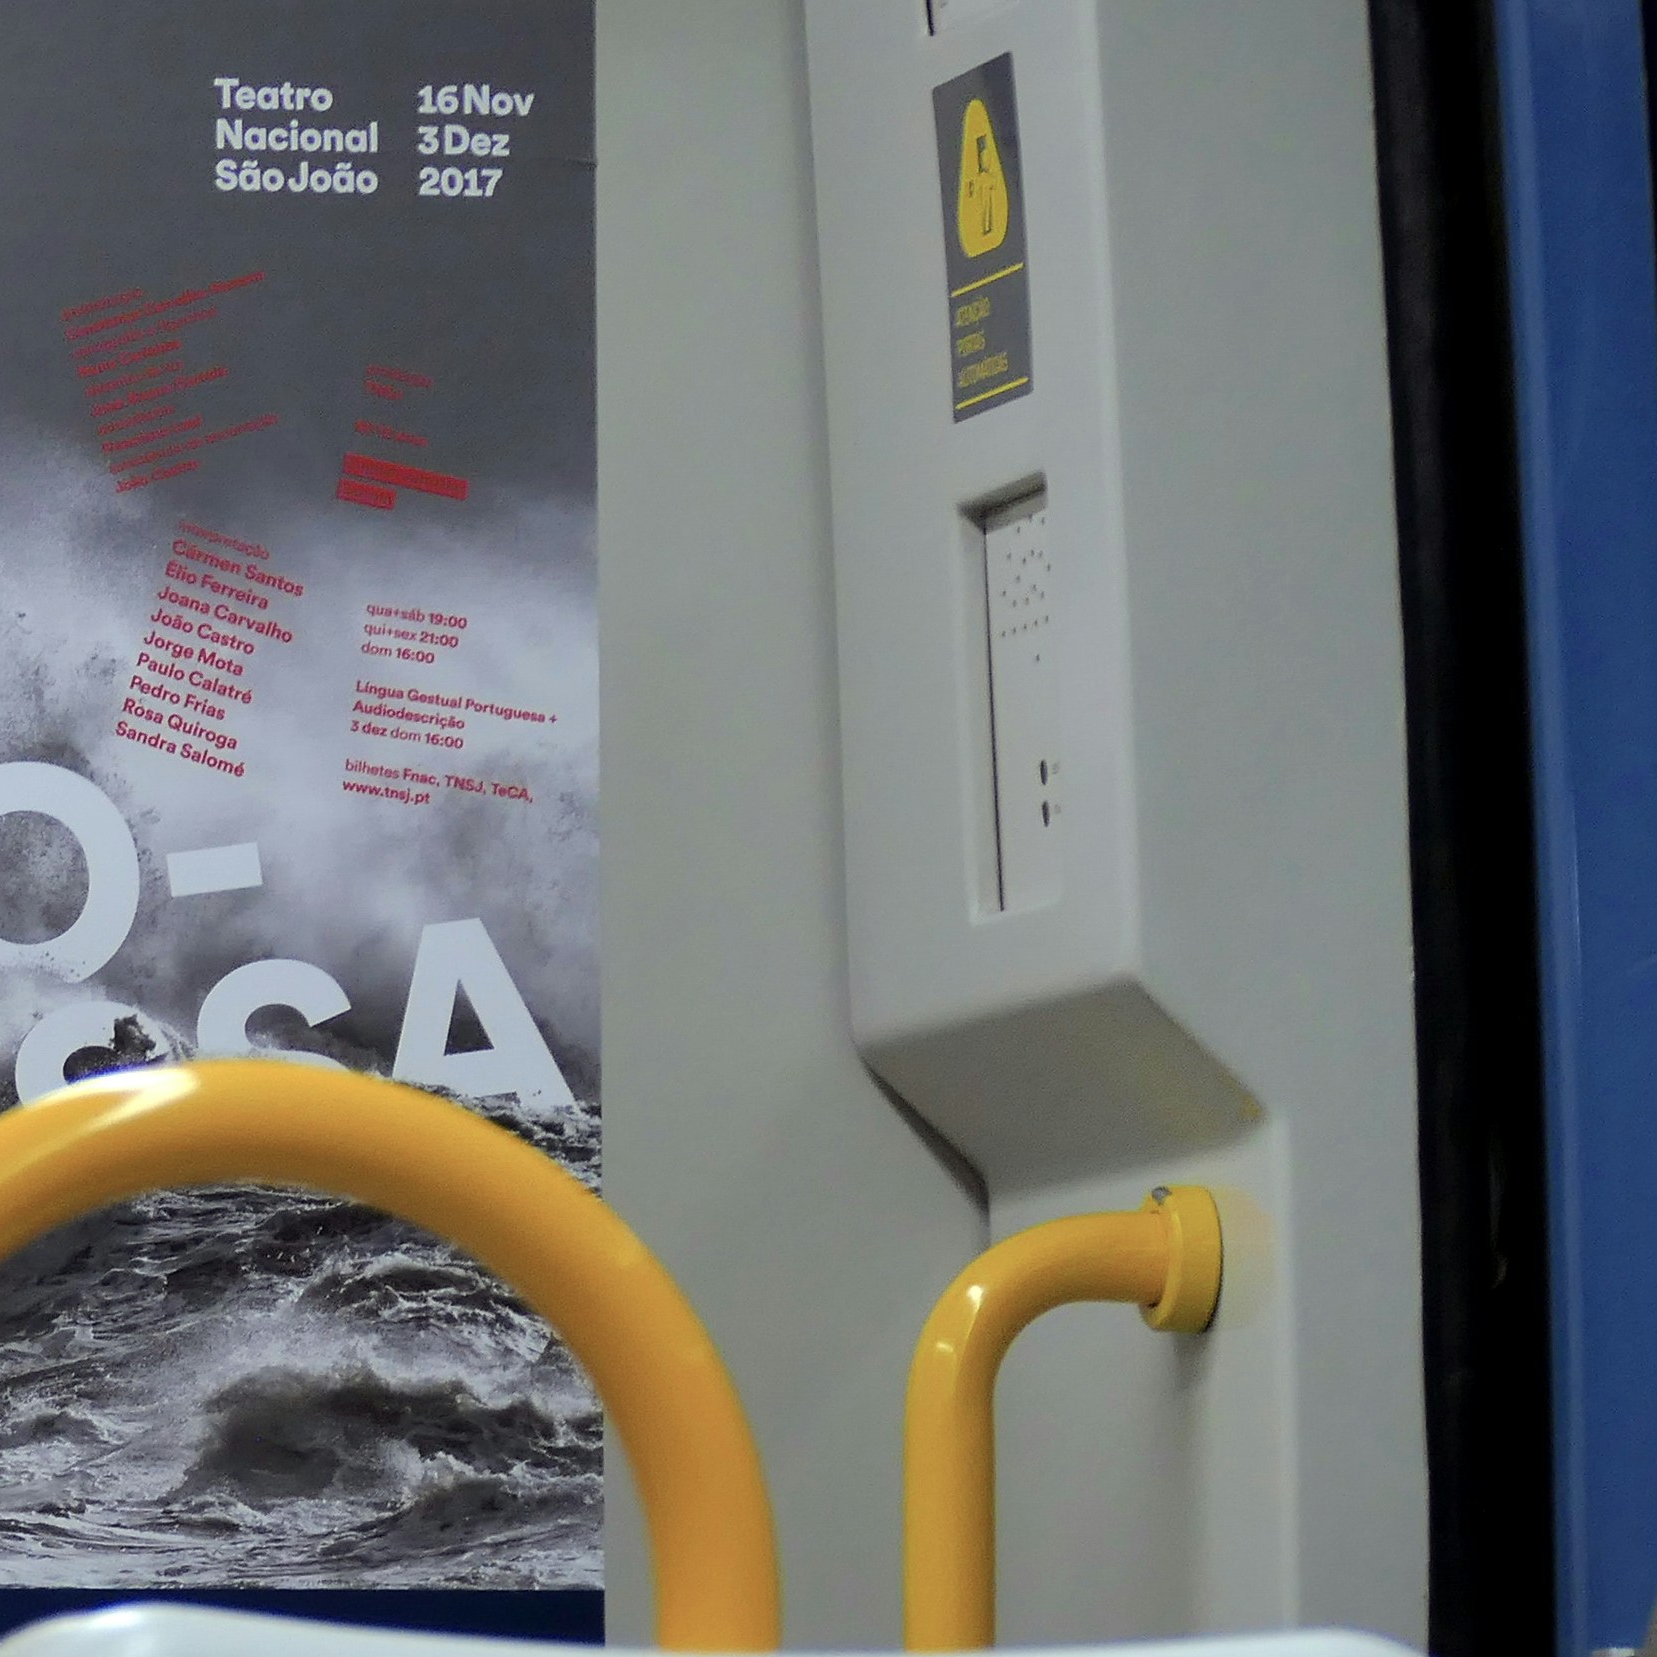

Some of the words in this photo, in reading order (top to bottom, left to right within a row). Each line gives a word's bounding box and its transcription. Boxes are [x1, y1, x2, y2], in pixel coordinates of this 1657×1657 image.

[214, 78, 333, 111] Teatro
[418, 85, 459, 114] 16
[463, 84, 535, 117] Nov
[216, 118, 378, 153] Nacional
[418, 126, 439, 155] 3
[443, 124, 510, 156] Dez
[215, 159, 284, 193] São
[288, 161, 378, 194] João
[418, 167, 503, 197] 2017
[201, 575, 269, 610] Ferreira
[244, 564, 304, 596] Santos
[158, 586, 209, 614] Joana
[214, 604, 292, 643] Carvalho
[429, 612, 467, 630] 19:00
[151, 608, 193, 633] João
[197, 623, 254, 655] Castro
[419, 631, 459, 648] 21:00
[143, 631, 194, 659] Jorge
[198, 648, 243, 676] Mota
[361, 641, 392, 657] dom
[136, 652, 185, 681] Paulo
[189, 671, 252, 704] Calatré
[355, 680, 404, 700] Língua
[407, 688, 462, 709] Gestual
[129, 675, 180, 704] Pedro
[184, 694, 226, 720] Frias
[122, 697, 163, 724] Rosa
[168, 713, 238, 750] Quiroga
[350, 720, 359, 732] 3
[362, 721, 387, 737] dez
[390, 726, 421, 742] dom
[353, 700, 465, 731] Audiodescrição
[116, 721, 176, 754] Sandra
[180, 743, 245, 777] Salomé
[342, 779, 431, 805] www.tnsj.pt
[345, 758, 399, 779] bilhetes
[445, 775, 487, 796] TNSJ,
[491, 783, 534, 803] TeCA,
